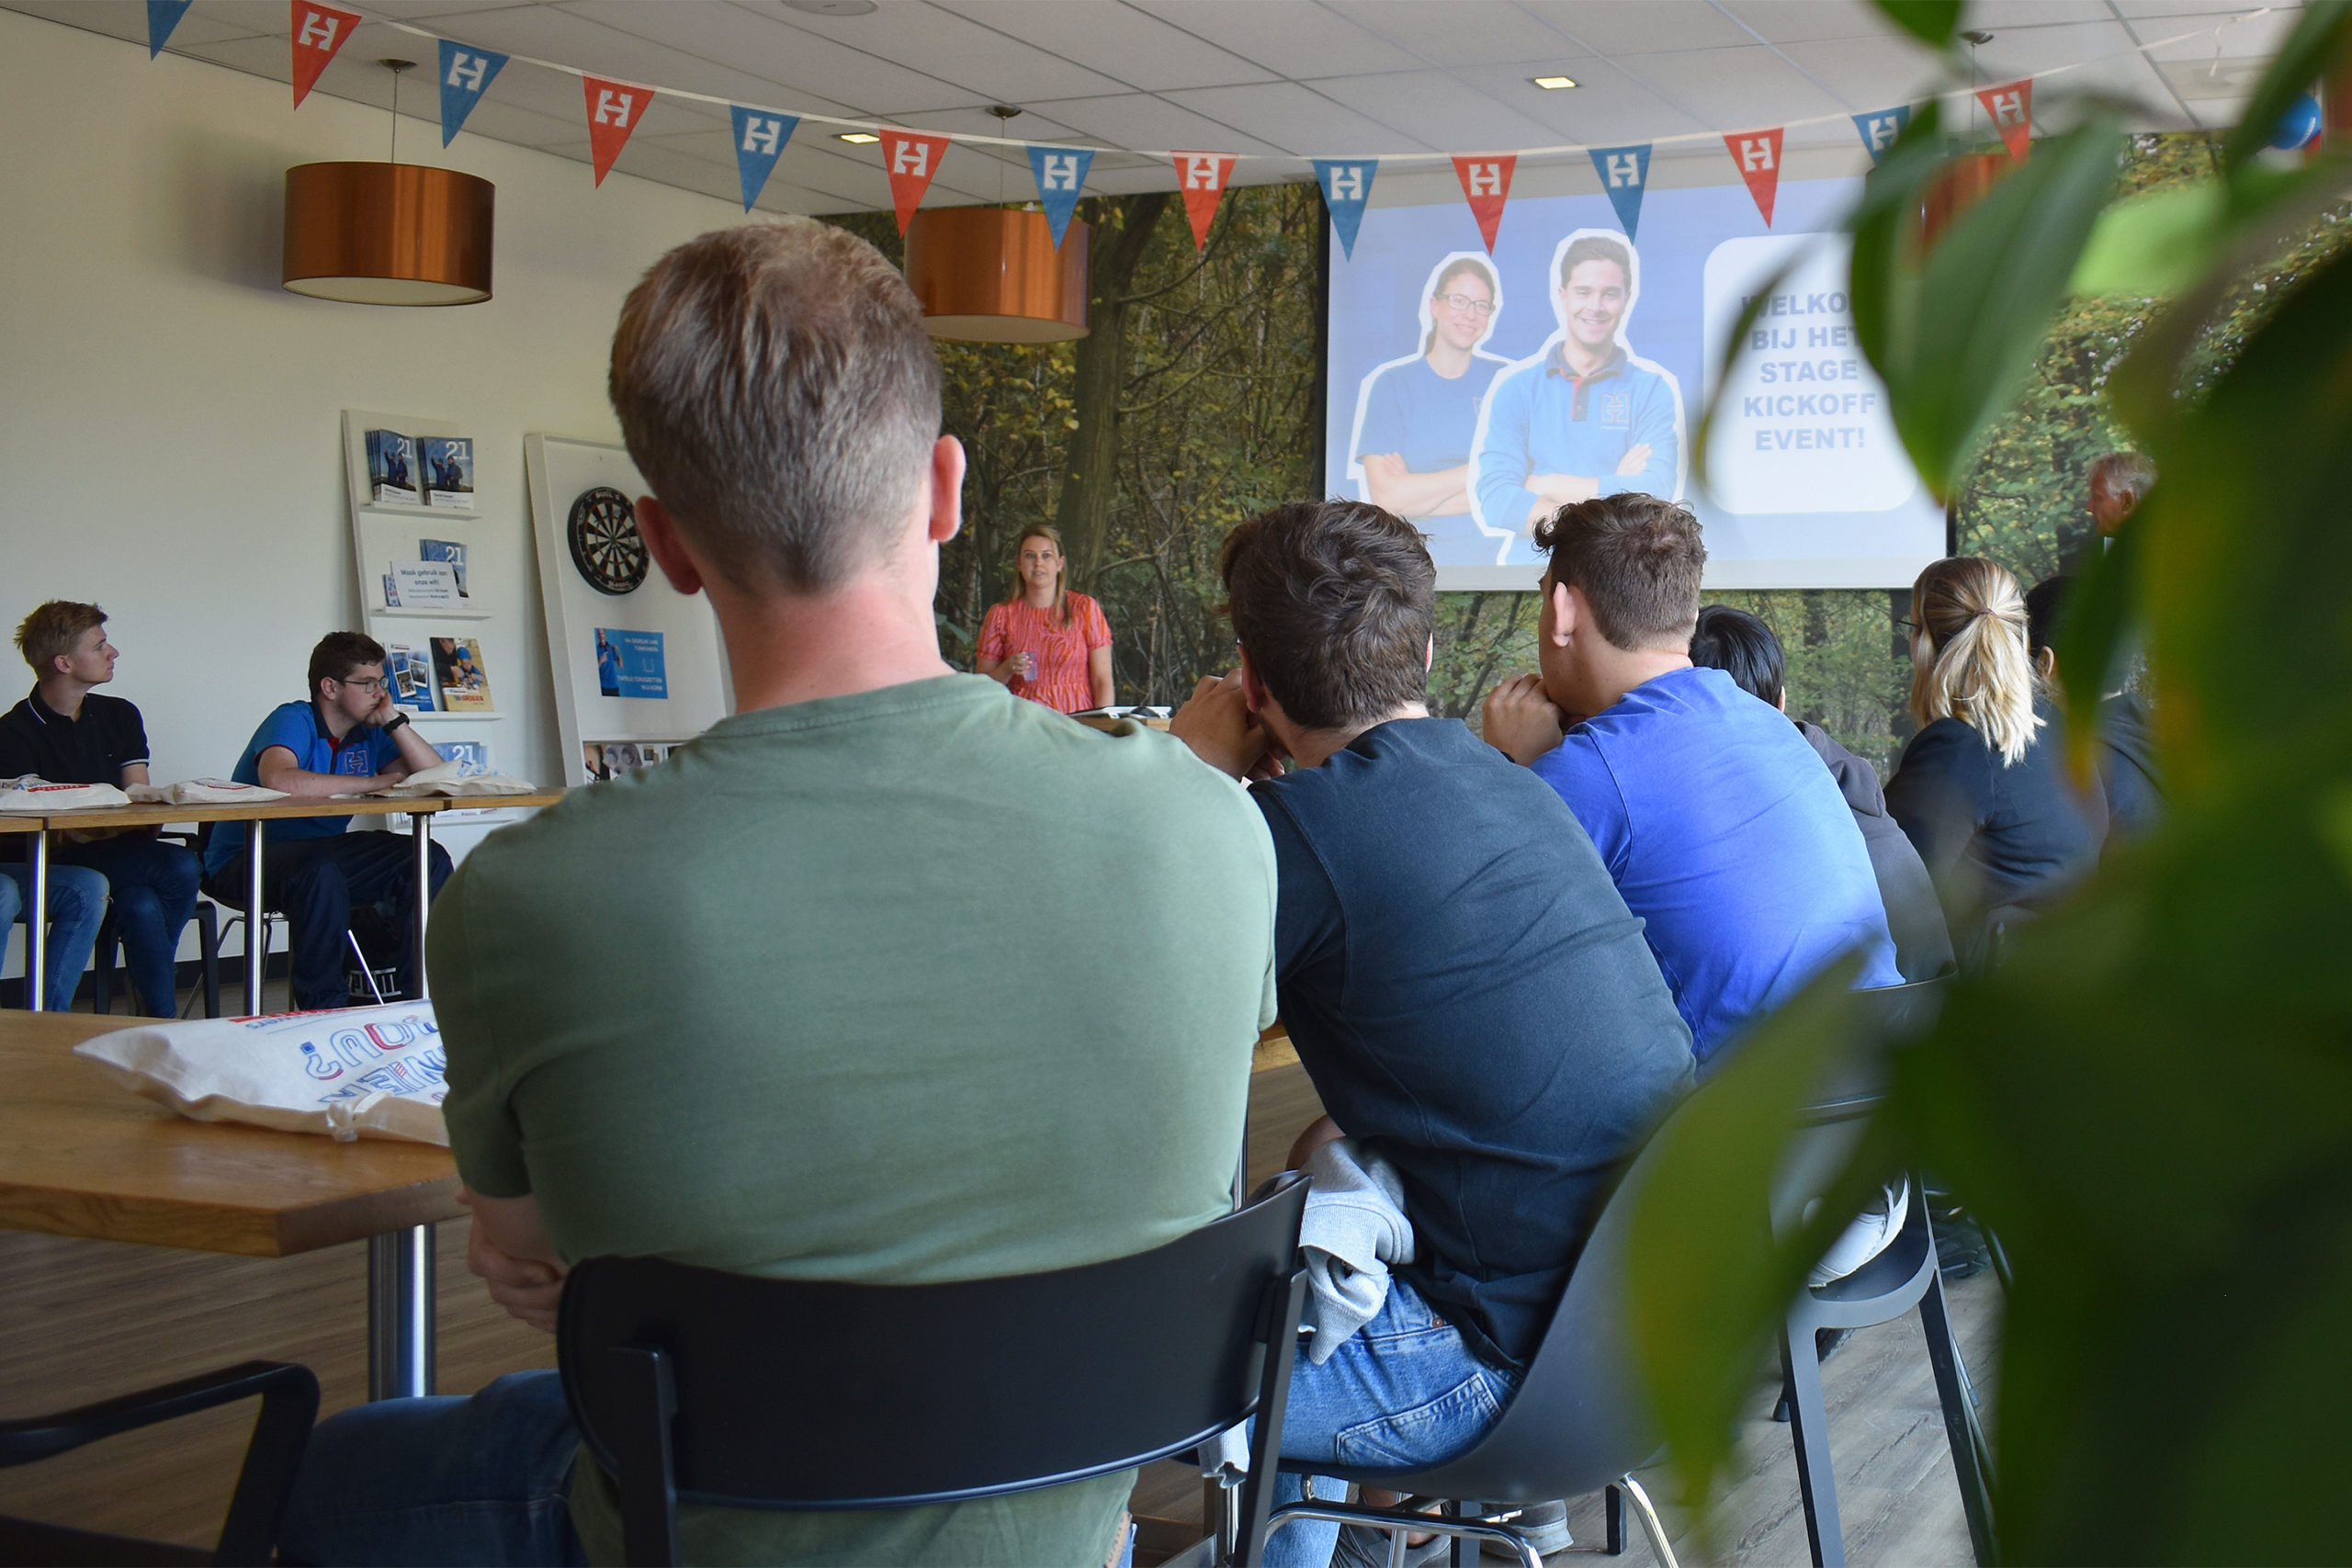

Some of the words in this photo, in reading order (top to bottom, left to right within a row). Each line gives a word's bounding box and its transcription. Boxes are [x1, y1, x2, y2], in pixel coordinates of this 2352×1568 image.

[299, 12, 338, 50] H
[447, 51, 487, 91] H
[595, 90, 632, 127] H
[1992, 91, 2026, 127] H
[741, 116, 781, 155] H
[1869, 116, 1898, 152] H
[894, 141, 929, 176] H
[1606, 152, 1640, 188] H
[1741, 137, 1774, 172] H
[1044, 154, 1078, 190] H
[1186, 157, 1219, 190] H
[1330, 166, 1363, 201] H
[1470, 163, 1502, 197] H
[1742, 292, 1849, 318] WELKO
[1752, 328, 1796, 350] BIJ
[1759, 359, 1859, 383] STAGE
[1745, 393, 1876, 417] KICKOFF
[397, 437, 413, 459] 21
[446, 441, 469, 460] 21
[1756, 427, 1866, 452] EVENT!
[446, 546, 464, 566] 21
[452, 745, 476, 763] 21
